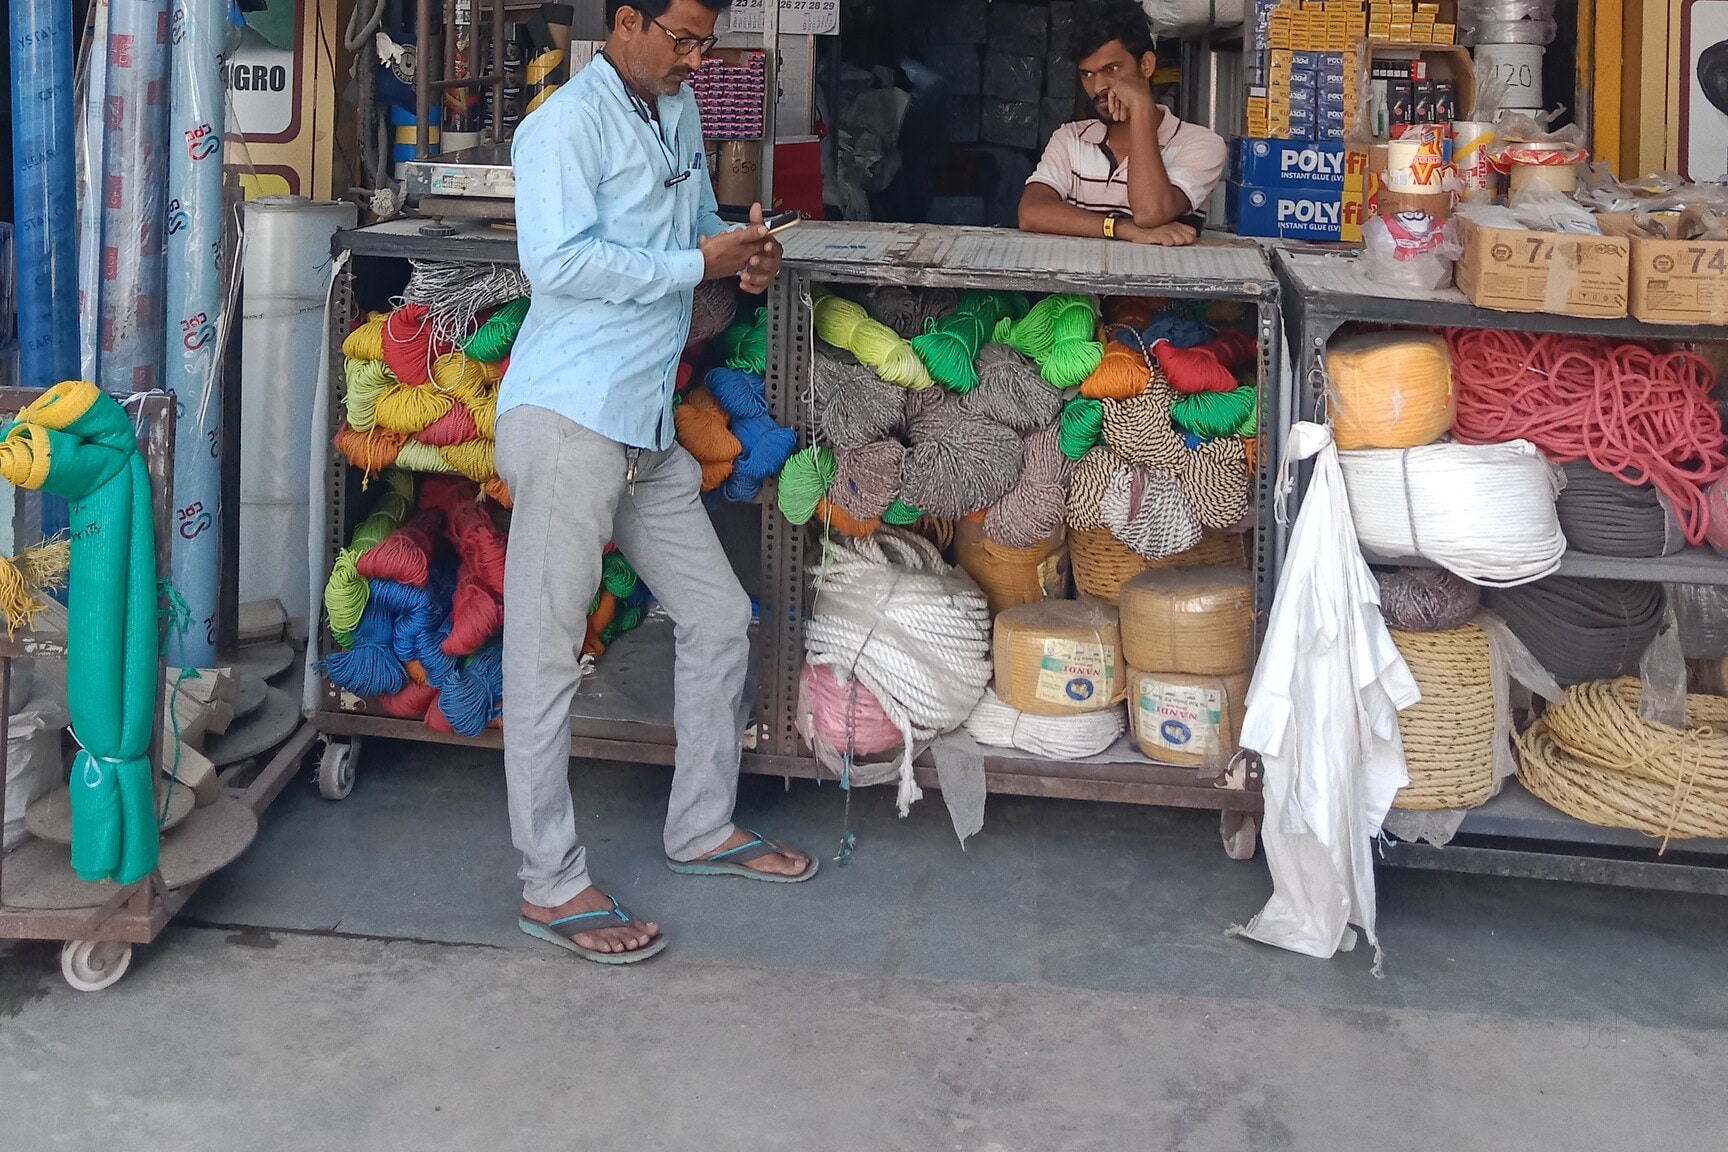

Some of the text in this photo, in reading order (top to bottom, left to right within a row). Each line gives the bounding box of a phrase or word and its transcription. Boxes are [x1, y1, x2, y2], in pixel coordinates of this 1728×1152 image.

[736, 0, 834, 10] 23 24 26 27 28 29
[226, 64, 287, 92] GRO
[1281, 149, 1368, 175] POLYfi
[1281, 172, 1311, 180] INSTANT
[1312, 173, 1330, 181] GLUE
[1277, 199, 1363, 226] POLYfi
[1278, 221, 1308, 230] INSTANT
[1309, 223, 1327, 231] GLUE
[1064, 665, 1101, 676] NANDI
[1156, 706, 1198, 720] NANDI
